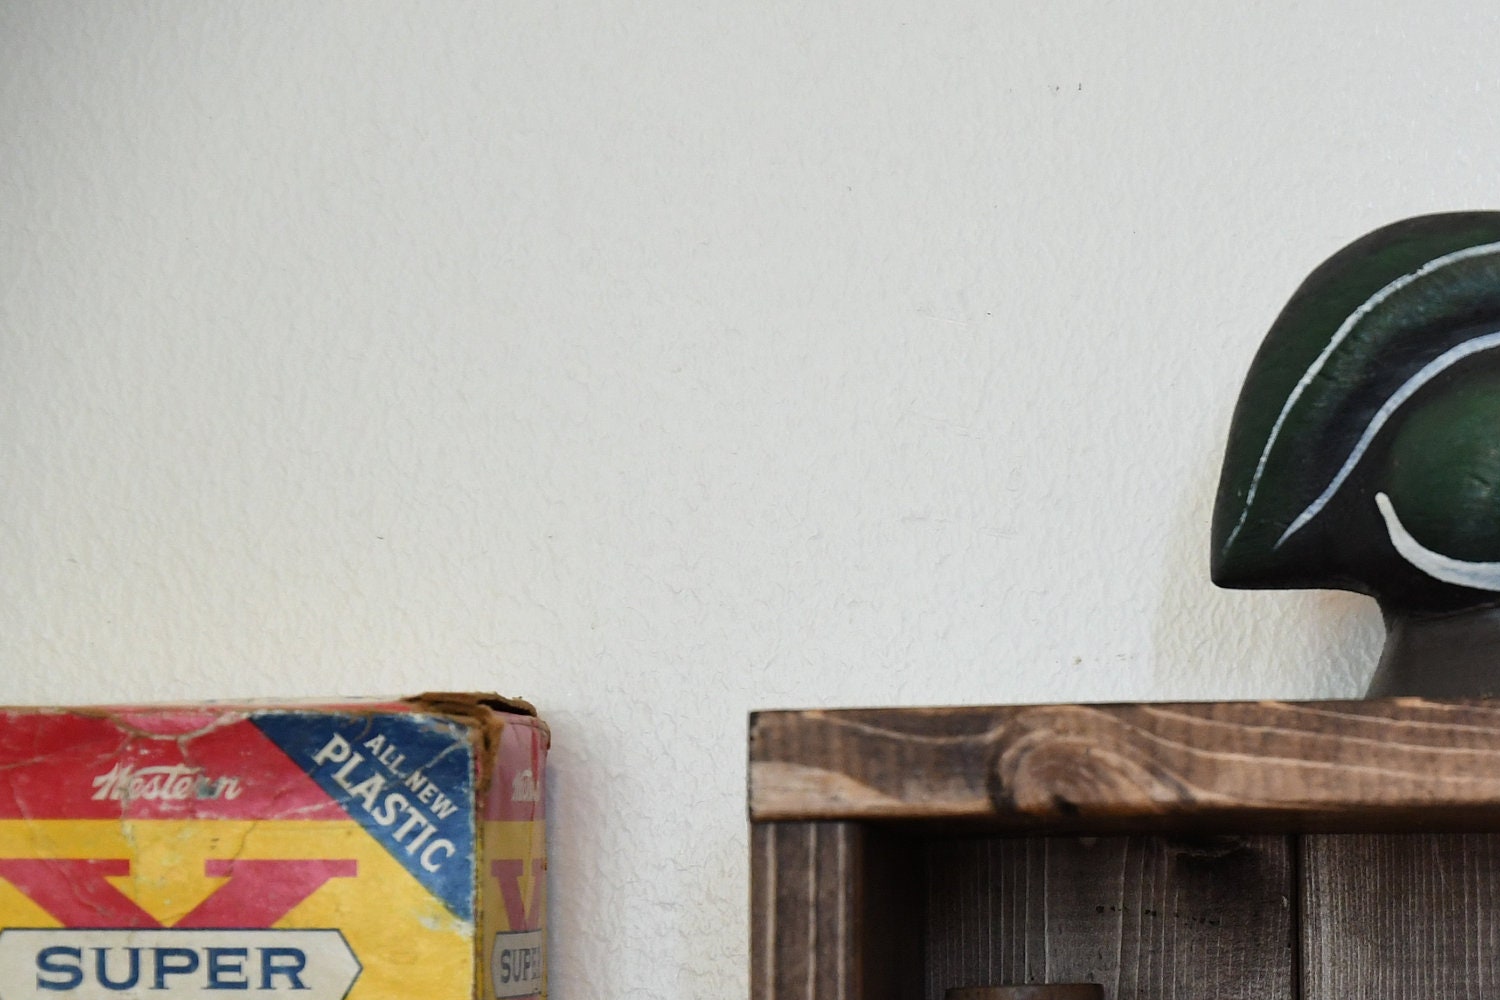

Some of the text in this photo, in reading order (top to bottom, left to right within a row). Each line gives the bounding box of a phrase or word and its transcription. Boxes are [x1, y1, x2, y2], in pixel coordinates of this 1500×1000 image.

[312, 732, 456, 873] PLASTIC
[363, 734, 406, 776] ALL
[404, 769, 458, 820] NEW
[36, 945, 312, 992] SUPER
